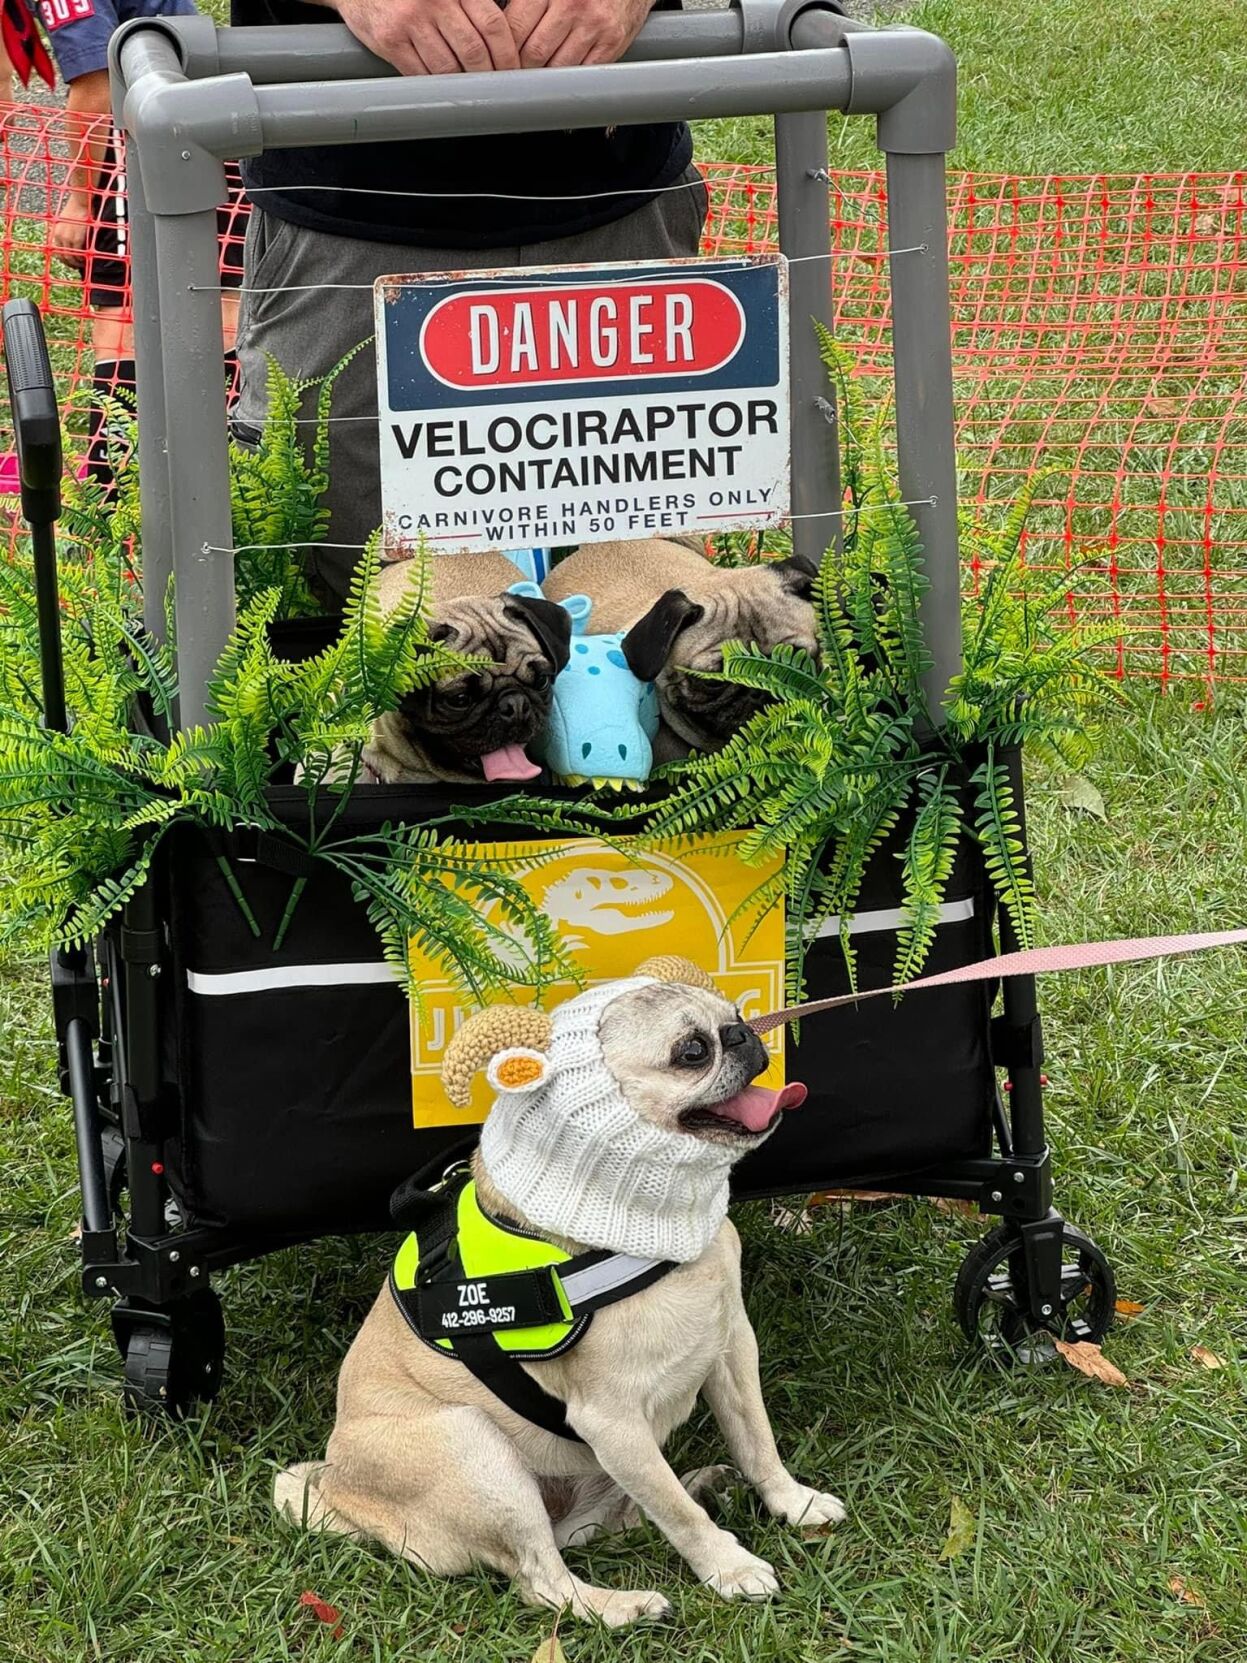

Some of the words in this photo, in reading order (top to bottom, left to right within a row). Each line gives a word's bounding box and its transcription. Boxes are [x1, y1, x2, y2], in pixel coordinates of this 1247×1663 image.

[469, 293, 694, 375] DANGER
[392, 400, 779, 459] VELOCIRAPTOR
[433, 446, 743, 498] CONTAINMENT
[398, 504, 549, 531] CARNIVORE
[561, 492, 696, 517] HANDLERS
[709, 488, 772, 507] ONLY
[485, 521, 576, 542] WITHIN
[589, 516, 615, 533] 50
[628, 512, 690, 530] FEET
[457, 1283, 491, 1307] ZOE
[441, 1306, 516, 1329] 412-296-9257
